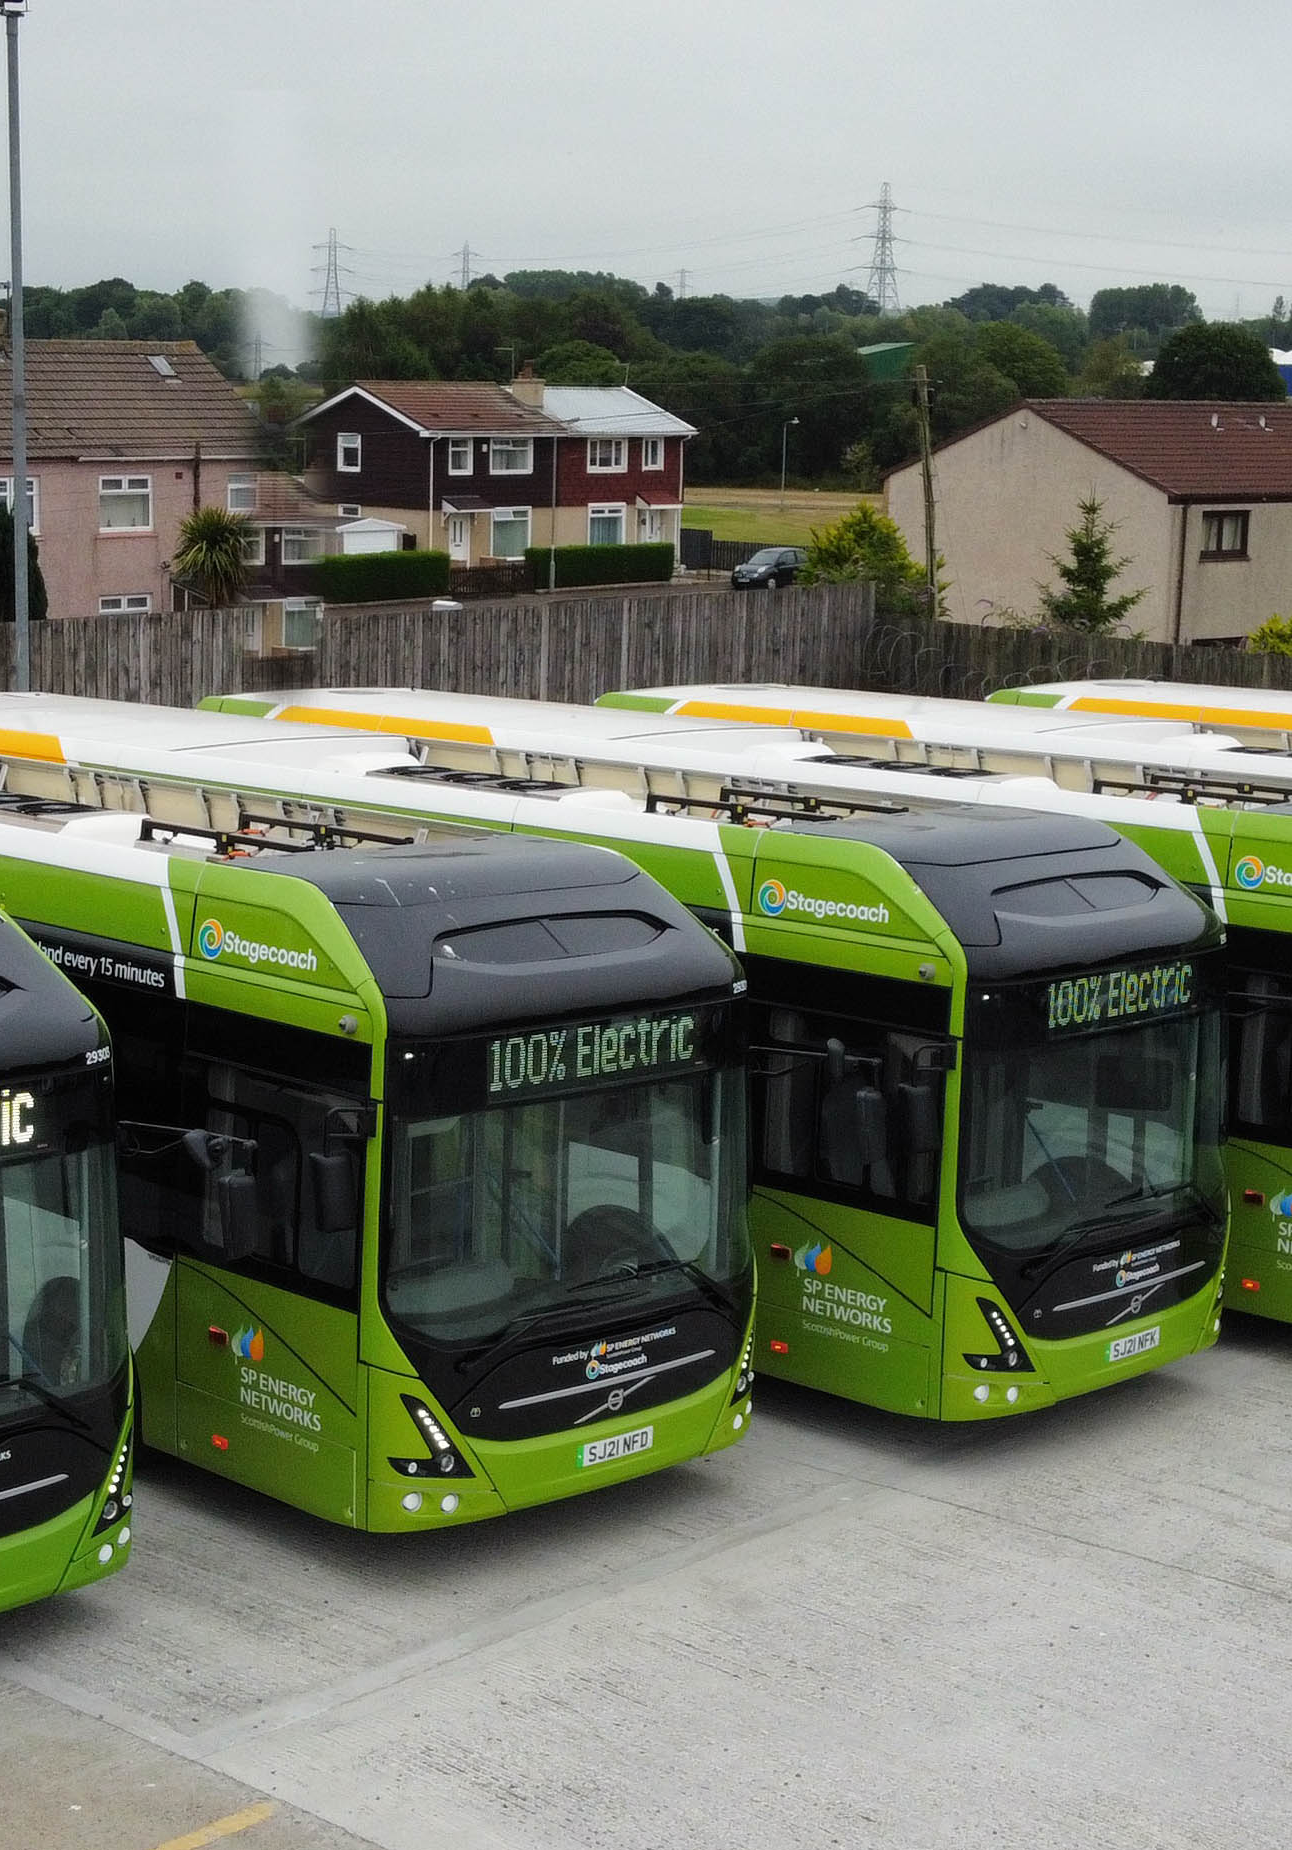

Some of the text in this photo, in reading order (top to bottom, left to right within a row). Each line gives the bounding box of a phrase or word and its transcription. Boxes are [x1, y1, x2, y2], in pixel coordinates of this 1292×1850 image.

[786, 890, 889, 924] Stagecoach
[64, 951, 98, 977] every
[99, 957, 113, 975] 15
[114, 962, 165, 988] minutes
[224, 930, 317, 972] Stagecoach
[1048, 962, 1193, 1029] 100% Electric
[490, 1015, 694, 1092] 100% Electric
[804, 1278, 887, 1313] SP ENERGY
[803, 1295, 892, 1334] NETWORKS
[862, 1336, 888, 1353] Group
[1114, 1331, 1157, 1358] SJ21 NFK
[598, 1354, 648, 1374] Stagecoach
[240, 1366, 316, 1409] SP ENERGY
[240, 1386, 321, 1432] NETWORKS
[589, 1431, 649, 1463] SJ21 NFD
